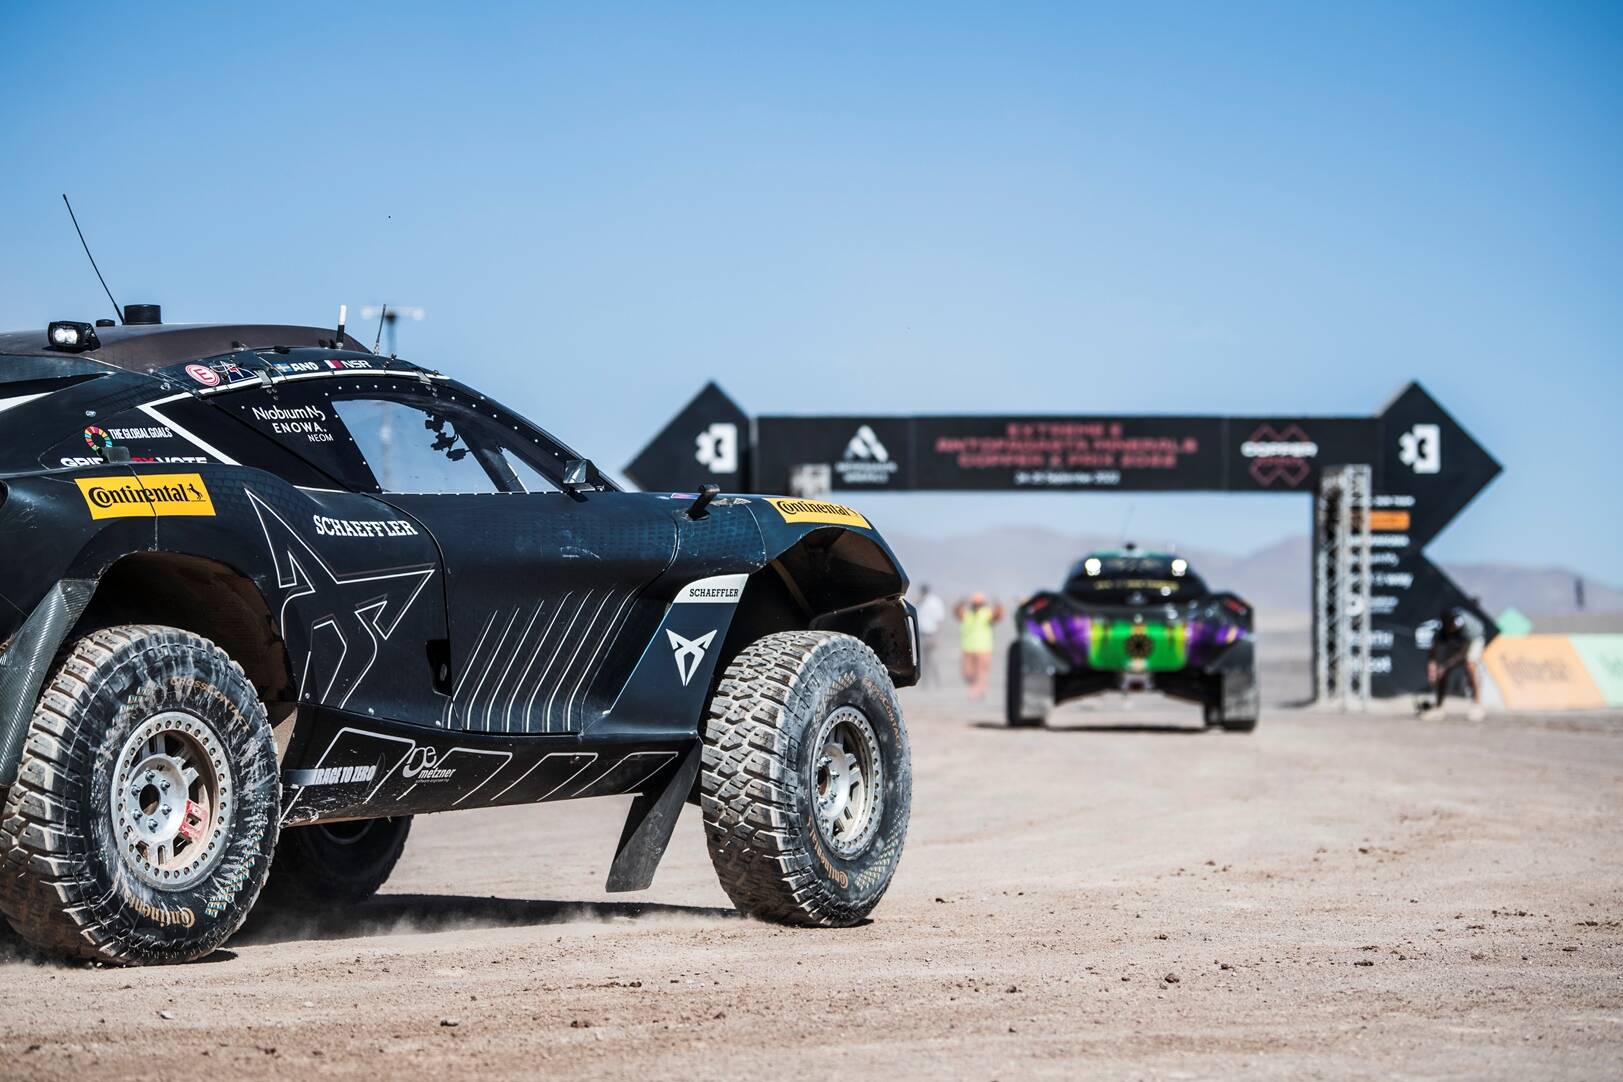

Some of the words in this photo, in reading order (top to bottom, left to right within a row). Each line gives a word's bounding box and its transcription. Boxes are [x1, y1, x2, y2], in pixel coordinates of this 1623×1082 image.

[290, 361, 319, 371] AND
[108, 429, 125, 439] THE
[122, 428, 150, 439] GLOBAL
[148, 427, 172, 438] GOALS
[308, 434, 334, 442] NEOM
[88, 483, 190, 508] Continental
[776, 501, 851, 516] Continental
[313, 515, 419, 537] SCHAEFFLER
[689, 588, 739, 598] SCHAEFFLER
[418, 767, 457, 779] metzner
